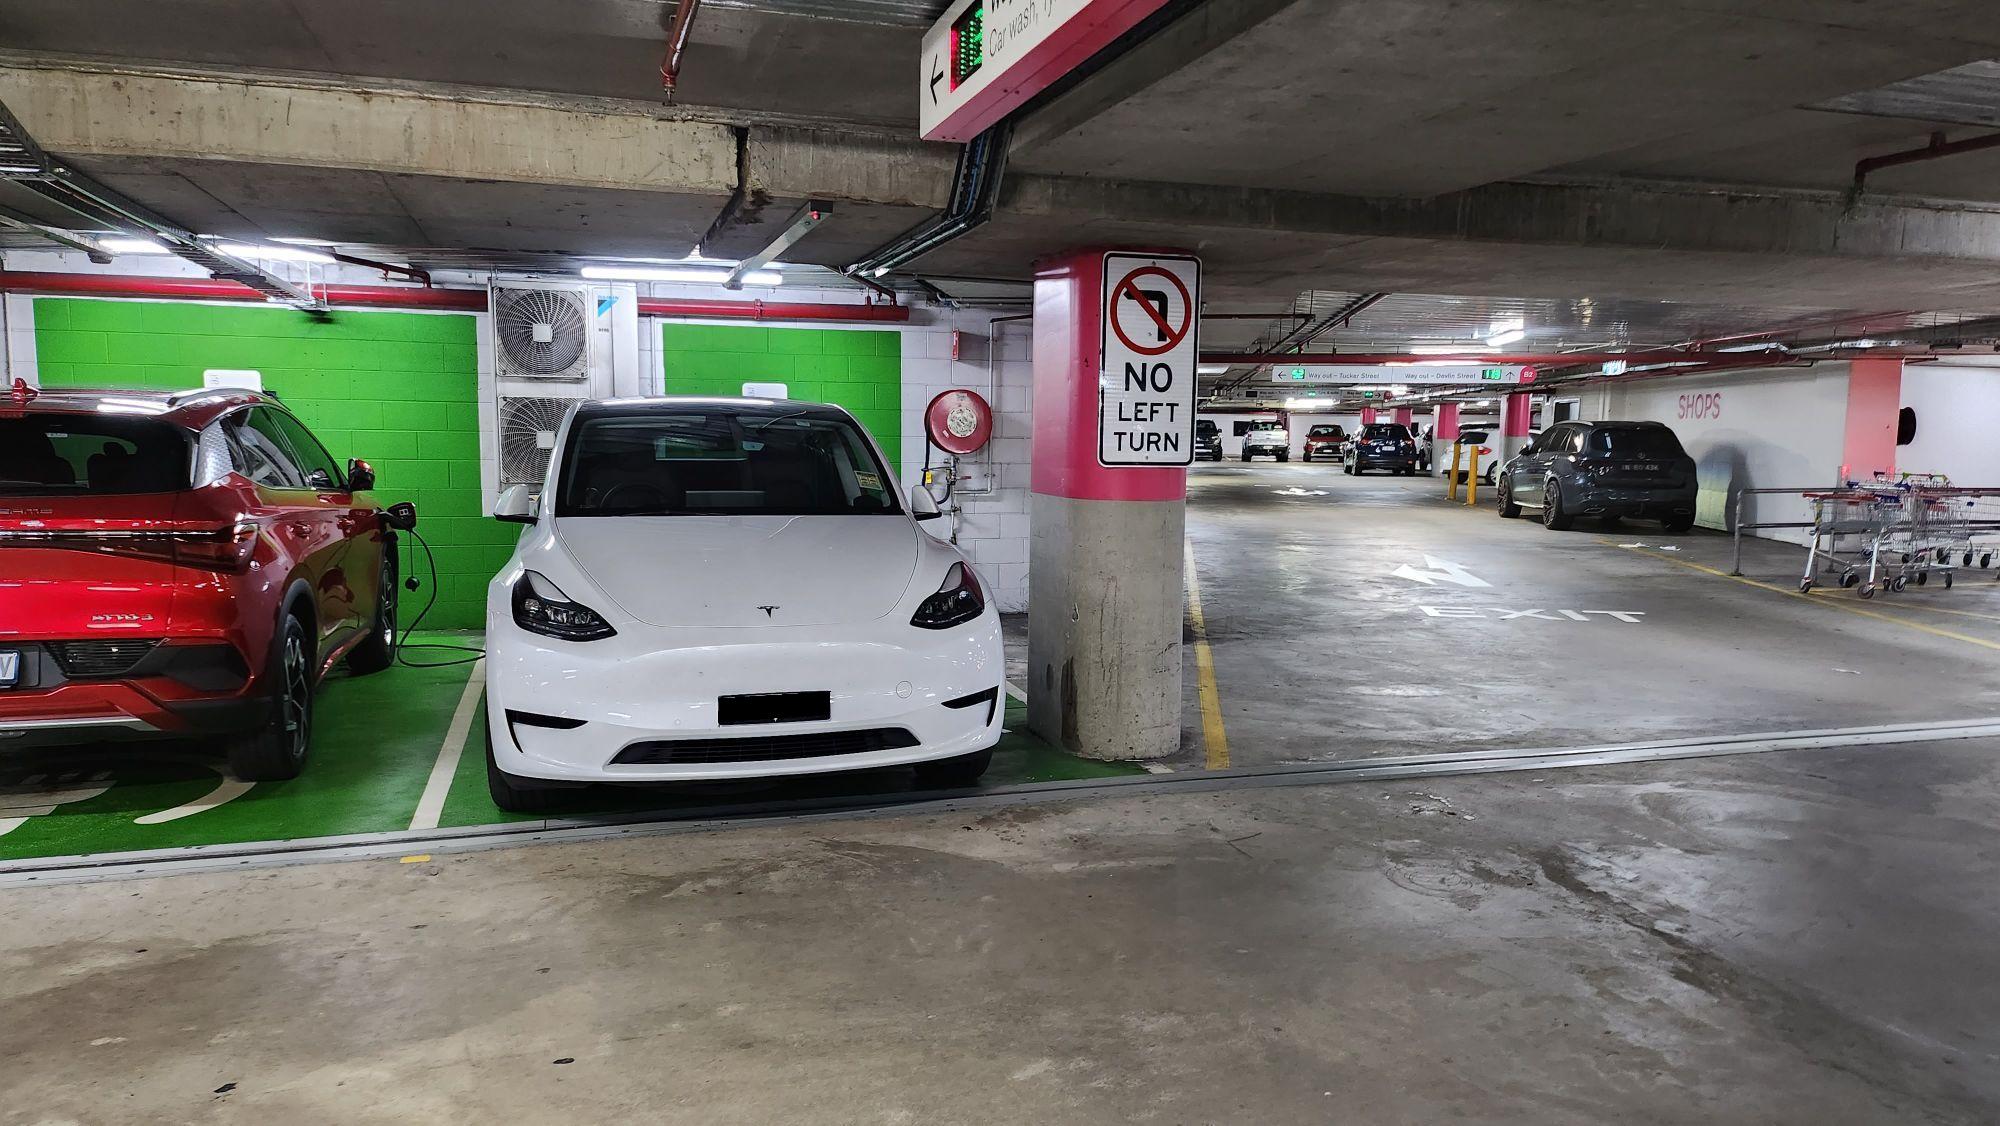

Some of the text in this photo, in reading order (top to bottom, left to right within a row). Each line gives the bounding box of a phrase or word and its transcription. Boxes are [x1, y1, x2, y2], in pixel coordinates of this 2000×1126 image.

[990, 28, 1007, 57] Car
[1124, 362, 1173, 393] NO
[1523, 371, 1533, 379] B2
[1118, 402, 1179, 423] LEFT
[1678, 392, 1721, 419] SHOPS
[1113, 431, 1179, 452] TURN
[1418, 605, 1646, 623] EXIT
